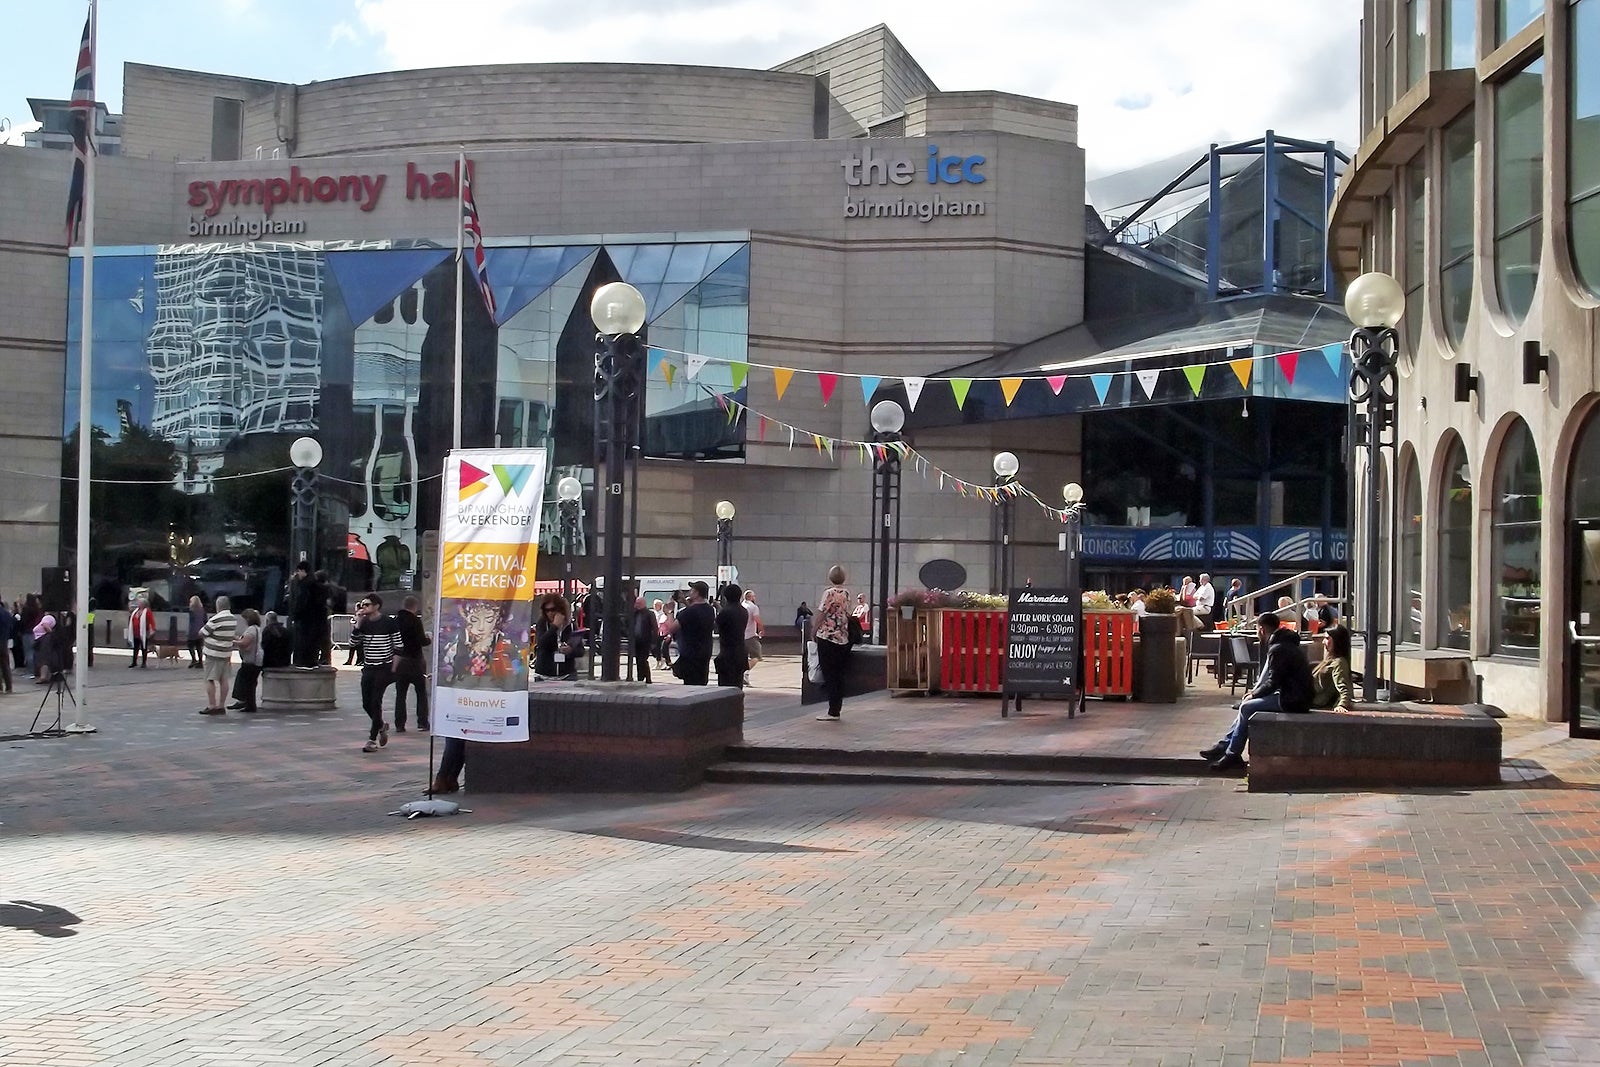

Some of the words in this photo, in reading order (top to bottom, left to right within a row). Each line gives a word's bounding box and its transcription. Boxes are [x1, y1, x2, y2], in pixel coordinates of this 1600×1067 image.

[841, 146, 915, 186] the
[927, 144, 986, 184] icc
[188, 165, 386, 217] symphony
[843, 194, 985, 223] birmingham
[188, 214, 305, 240] birmingham
[458, 515, 532, 526] WEEKENDER
[1083, 539, 1136, 556] CONGRESS
[1175, 540, 1228, 558] CONGSS
[453, 553, 527, 571] FESTIVAL
[454, 573, 527, 588] WEEKEND
[1017, 592, 1069, 603] Marmalade
[1011, 613, 1031, 622] AFTER
[1032, 614, 1051, 622] WORK
[1052, 614, 1074, 623] SOCIAL
[1009, 644, 1037, 659] ENJOY
[458, 697, 506, 708] #BhamWE
